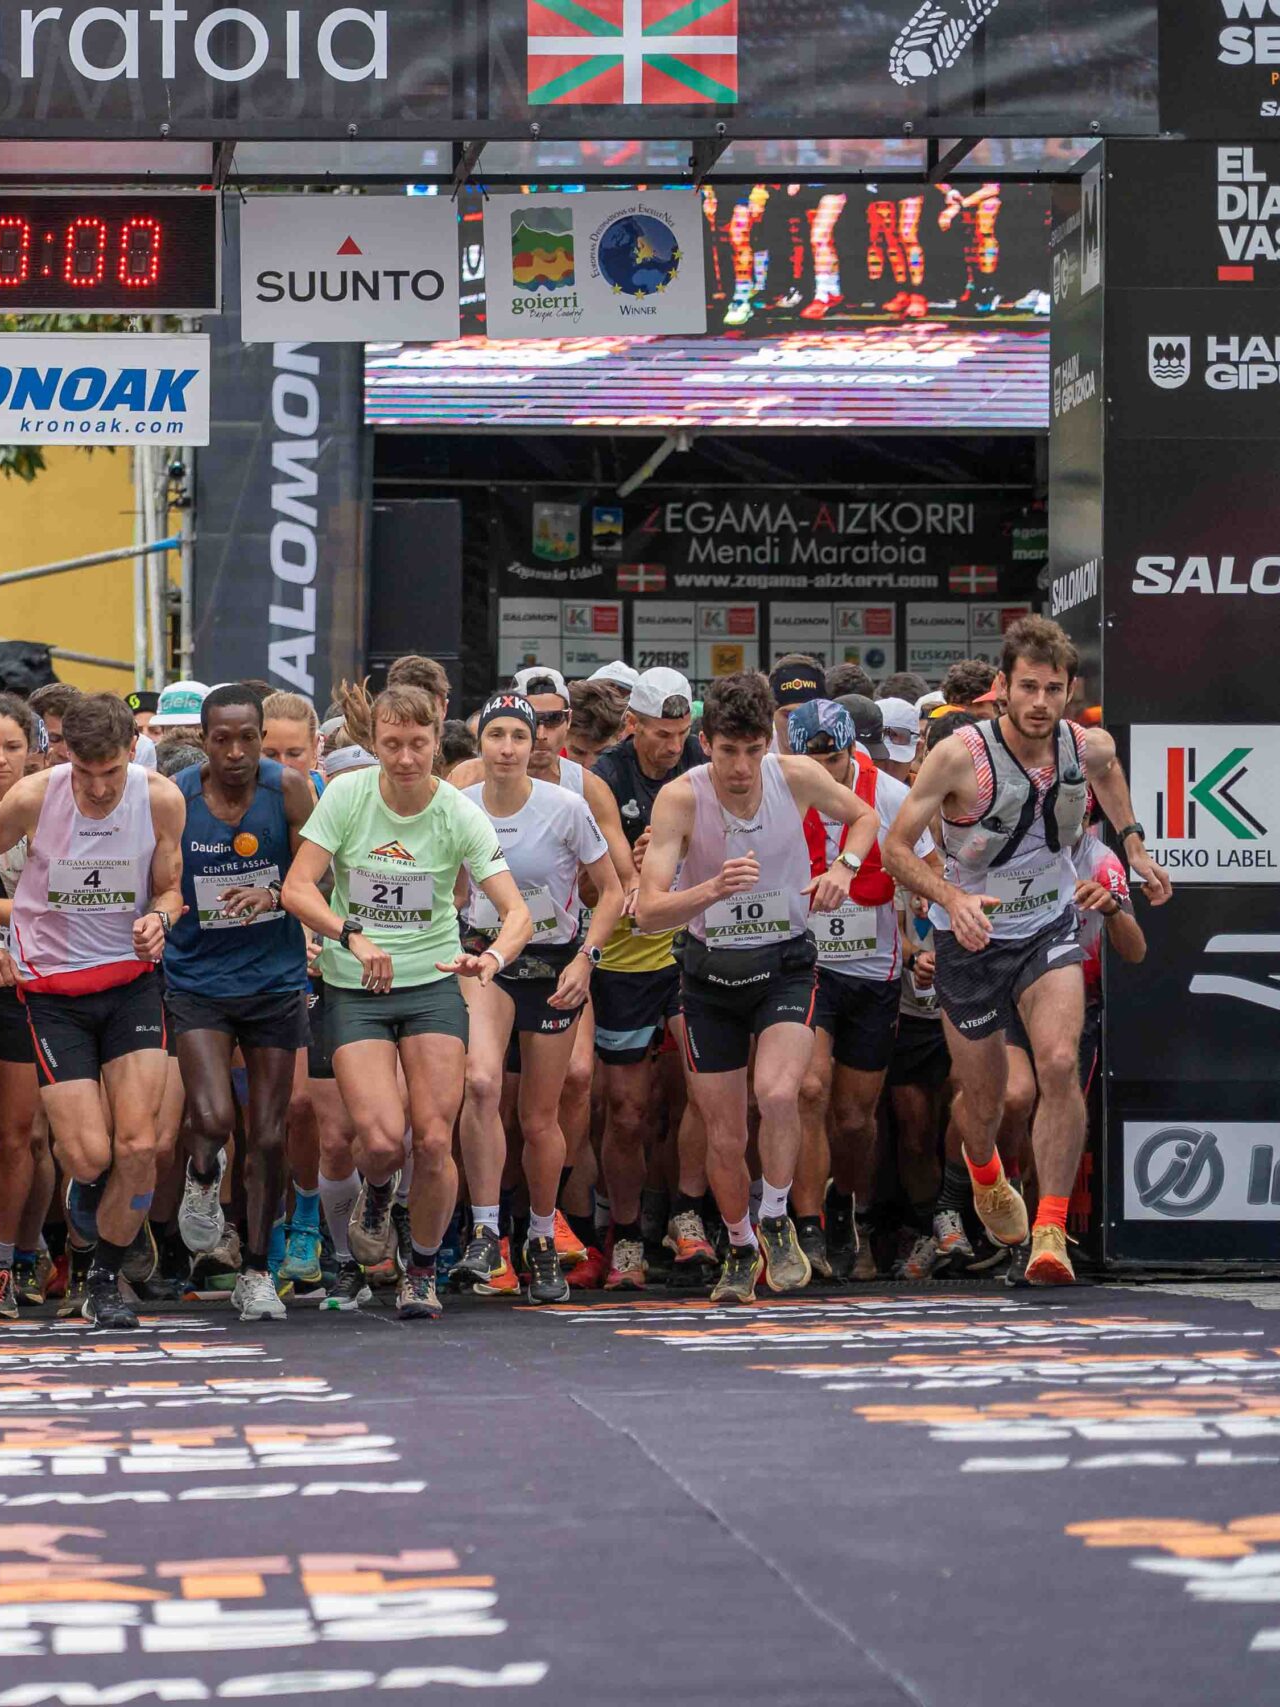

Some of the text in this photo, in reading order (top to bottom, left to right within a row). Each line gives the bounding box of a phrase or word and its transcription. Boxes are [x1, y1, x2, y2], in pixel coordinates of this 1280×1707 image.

[1218, 147, 1267, 182] EL
[256, 269, 445, 303] SUUNTO
[511, 292, 578, 315] goierri
[1205, 363, 1280, 390] GIP
[20, 416, 184, 434] kronoak.com
[268, 342, 320, 700] ALOMON
[639, 501, 974, 535] ZEGAMA-AIZKORRI
[687, 537, 927, 565] Mendi Maratoia
[1052, 558, 1098, 617] SALOMON
[780, 678, 817, 691] CROWN
[190, 841, 232, 853] Daudin
[203, 858, 271, 874] CENTRE ASSAL
[367, 853, 389, 863] NIKE
[1216, 849, 1278, 868] LABEL
[83, 869, 102, 889] 4
[1019, 878, 1035, 897] 7
[58, 893, 126, 905] ZEGAMA
[371, 884, 404, 906] 21
[991, 894, 1050, 914] ZEGAMA
[356, 905, 422, 922] ZEGAMA
[730, 903, 764, 921] 10
[715, 922, 780, 937] ZEGAMA
[829, 918, 845, 937] 8
[816, 939, 868, 952] EGAMA
[707, 971, 771, 987] SALOMON
[966, 1009, 998, 1029] TERREX
